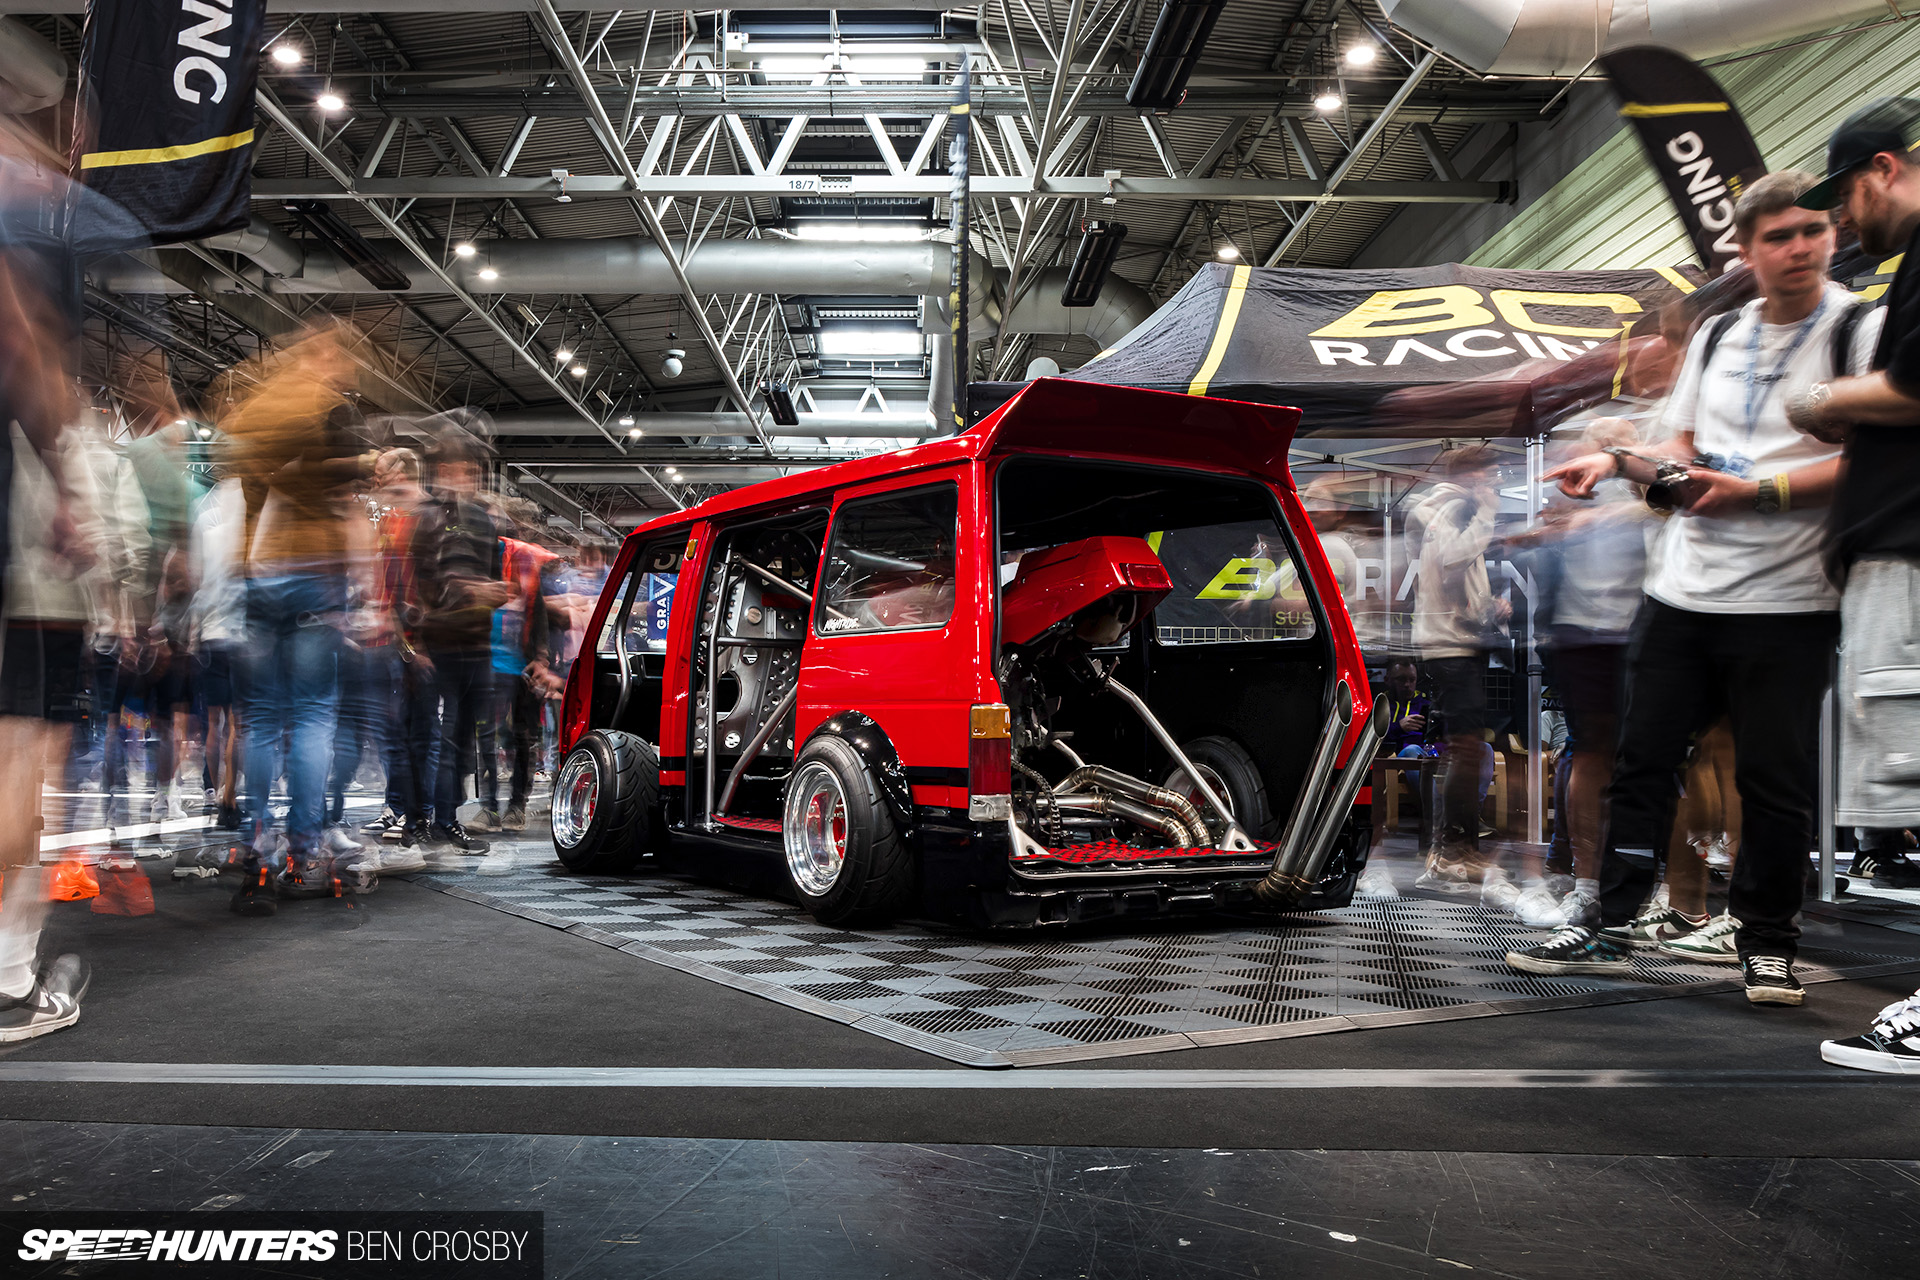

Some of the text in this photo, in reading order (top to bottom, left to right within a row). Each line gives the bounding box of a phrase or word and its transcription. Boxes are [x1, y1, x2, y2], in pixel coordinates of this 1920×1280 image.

[788, 180, 815, 190] 18/7
[1666, 131, 1747, 273] ACING
[1308, 285, 1644, 338] BC
[1309, 329, 1600, 366] RACIN
